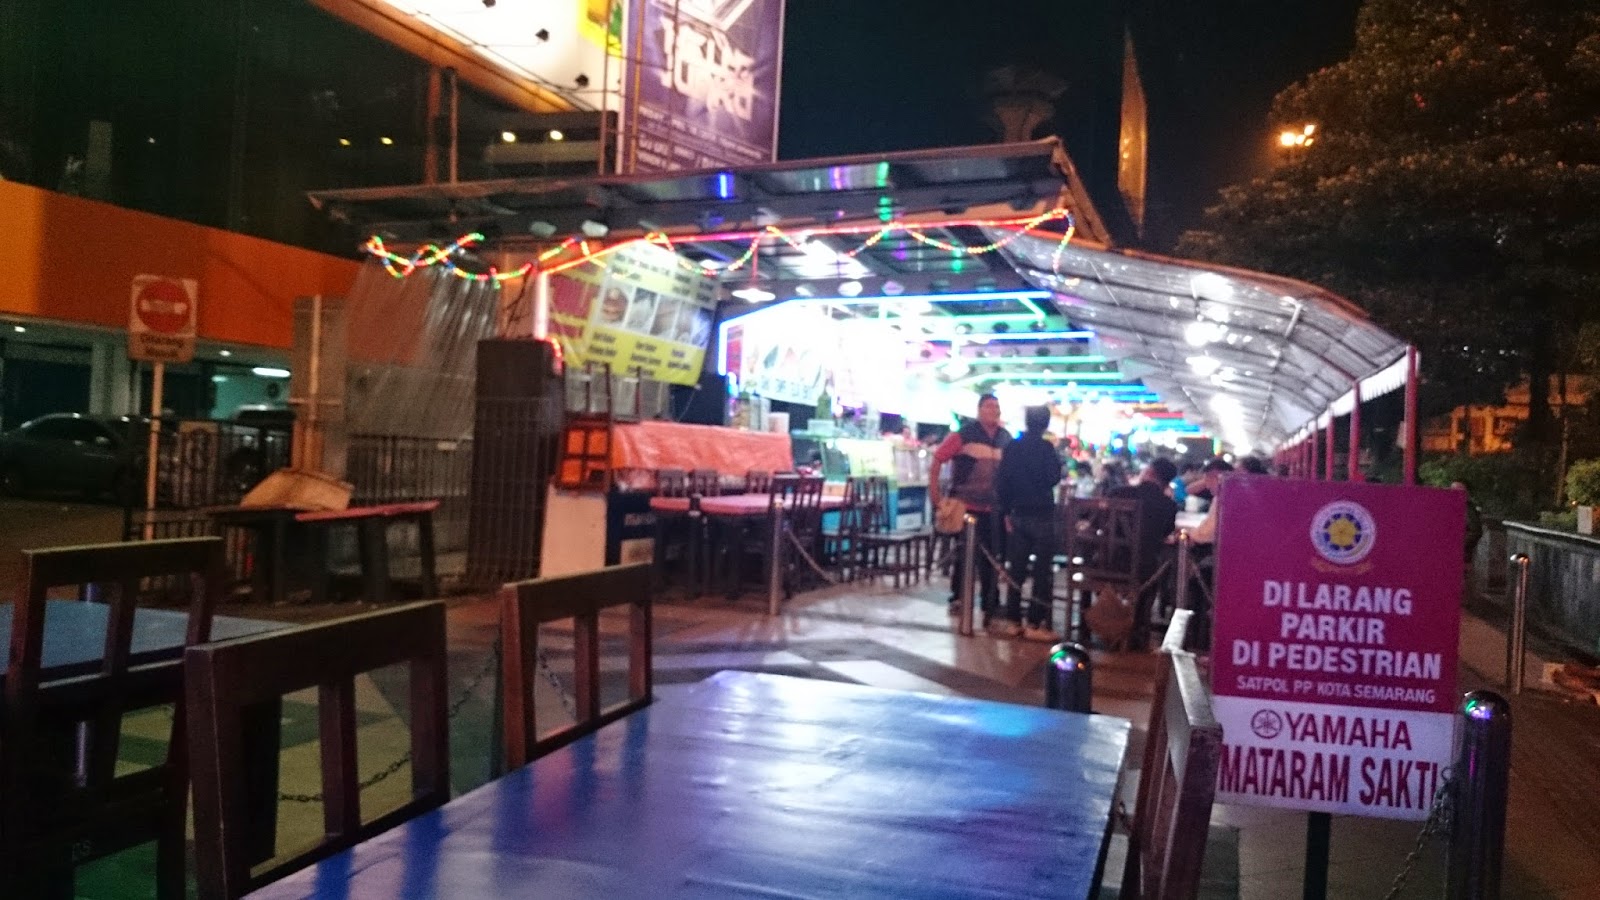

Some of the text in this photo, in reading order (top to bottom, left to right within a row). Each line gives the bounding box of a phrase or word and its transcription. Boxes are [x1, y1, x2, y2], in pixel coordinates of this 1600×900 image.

[1264, 580, 1413, 615] DI LARANG
[1281, 612, 1386, 645] PARKIR
[1232, 639, 1442, 680] DI PEDESTRIAN
[1236, 675, 1436, 704] SATPOL PP KOTA SEMARANG
[1285, 711, 1413, 751] YAMAHA
[1219, 743, 1439, 810] MATARAM SAKTI
